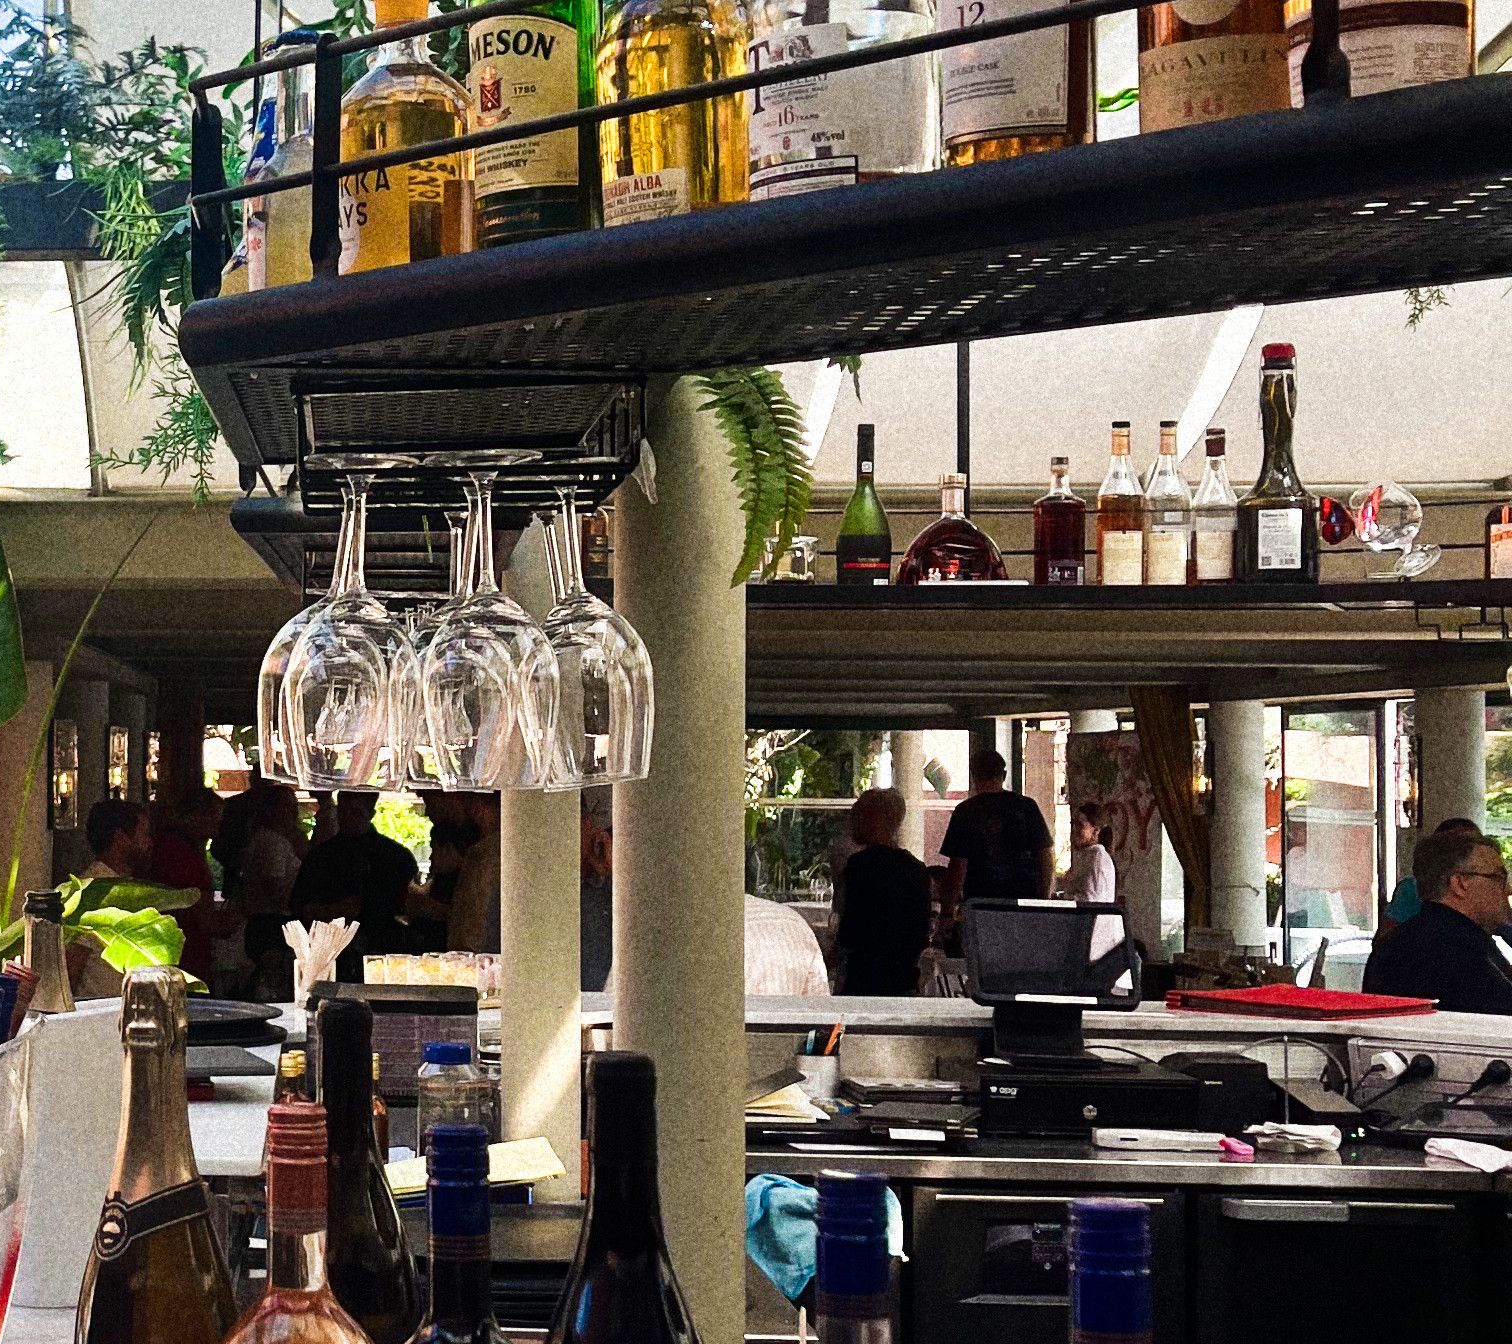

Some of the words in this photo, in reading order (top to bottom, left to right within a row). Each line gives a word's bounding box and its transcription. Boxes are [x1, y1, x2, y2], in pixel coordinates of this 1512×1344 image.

[957, 1, 985, 31] 12
[513, 84, 537, 95] 1780
[779, 105, 794, 127] 16
[633, 174, 662, 192] ALBA
